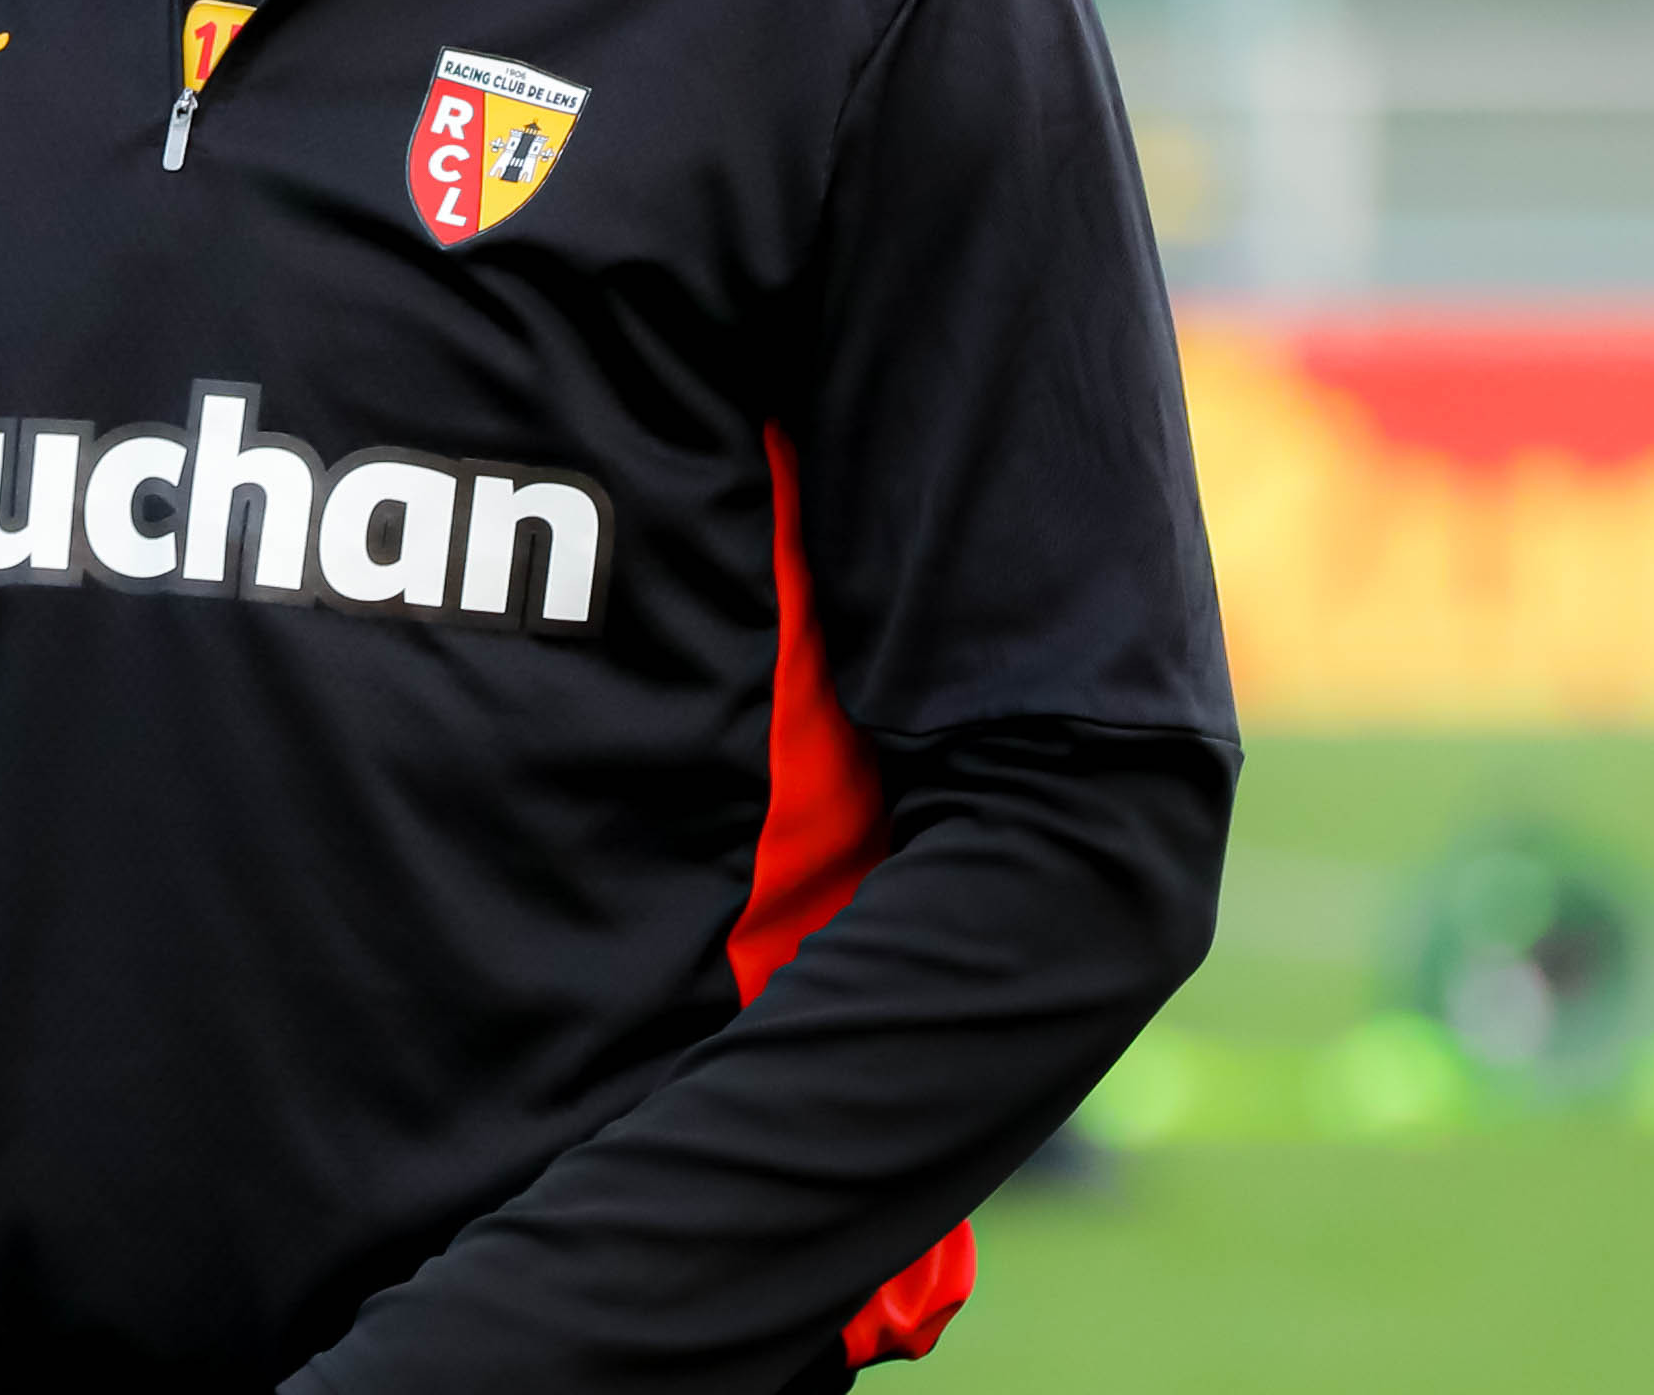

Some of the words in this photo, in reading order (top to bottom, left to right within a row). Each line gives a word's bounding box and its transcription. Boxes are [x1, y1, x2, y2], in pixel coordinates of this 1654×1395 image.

[194, 21, 244, 81] 1
[444, 60, 491, 85] RACING
[492, 75, 526, 96] CLUB
[526, 85, 545, 101] DE
[545, 90, 578, 109] LENS
[428, 94, 475, 227] RCL
